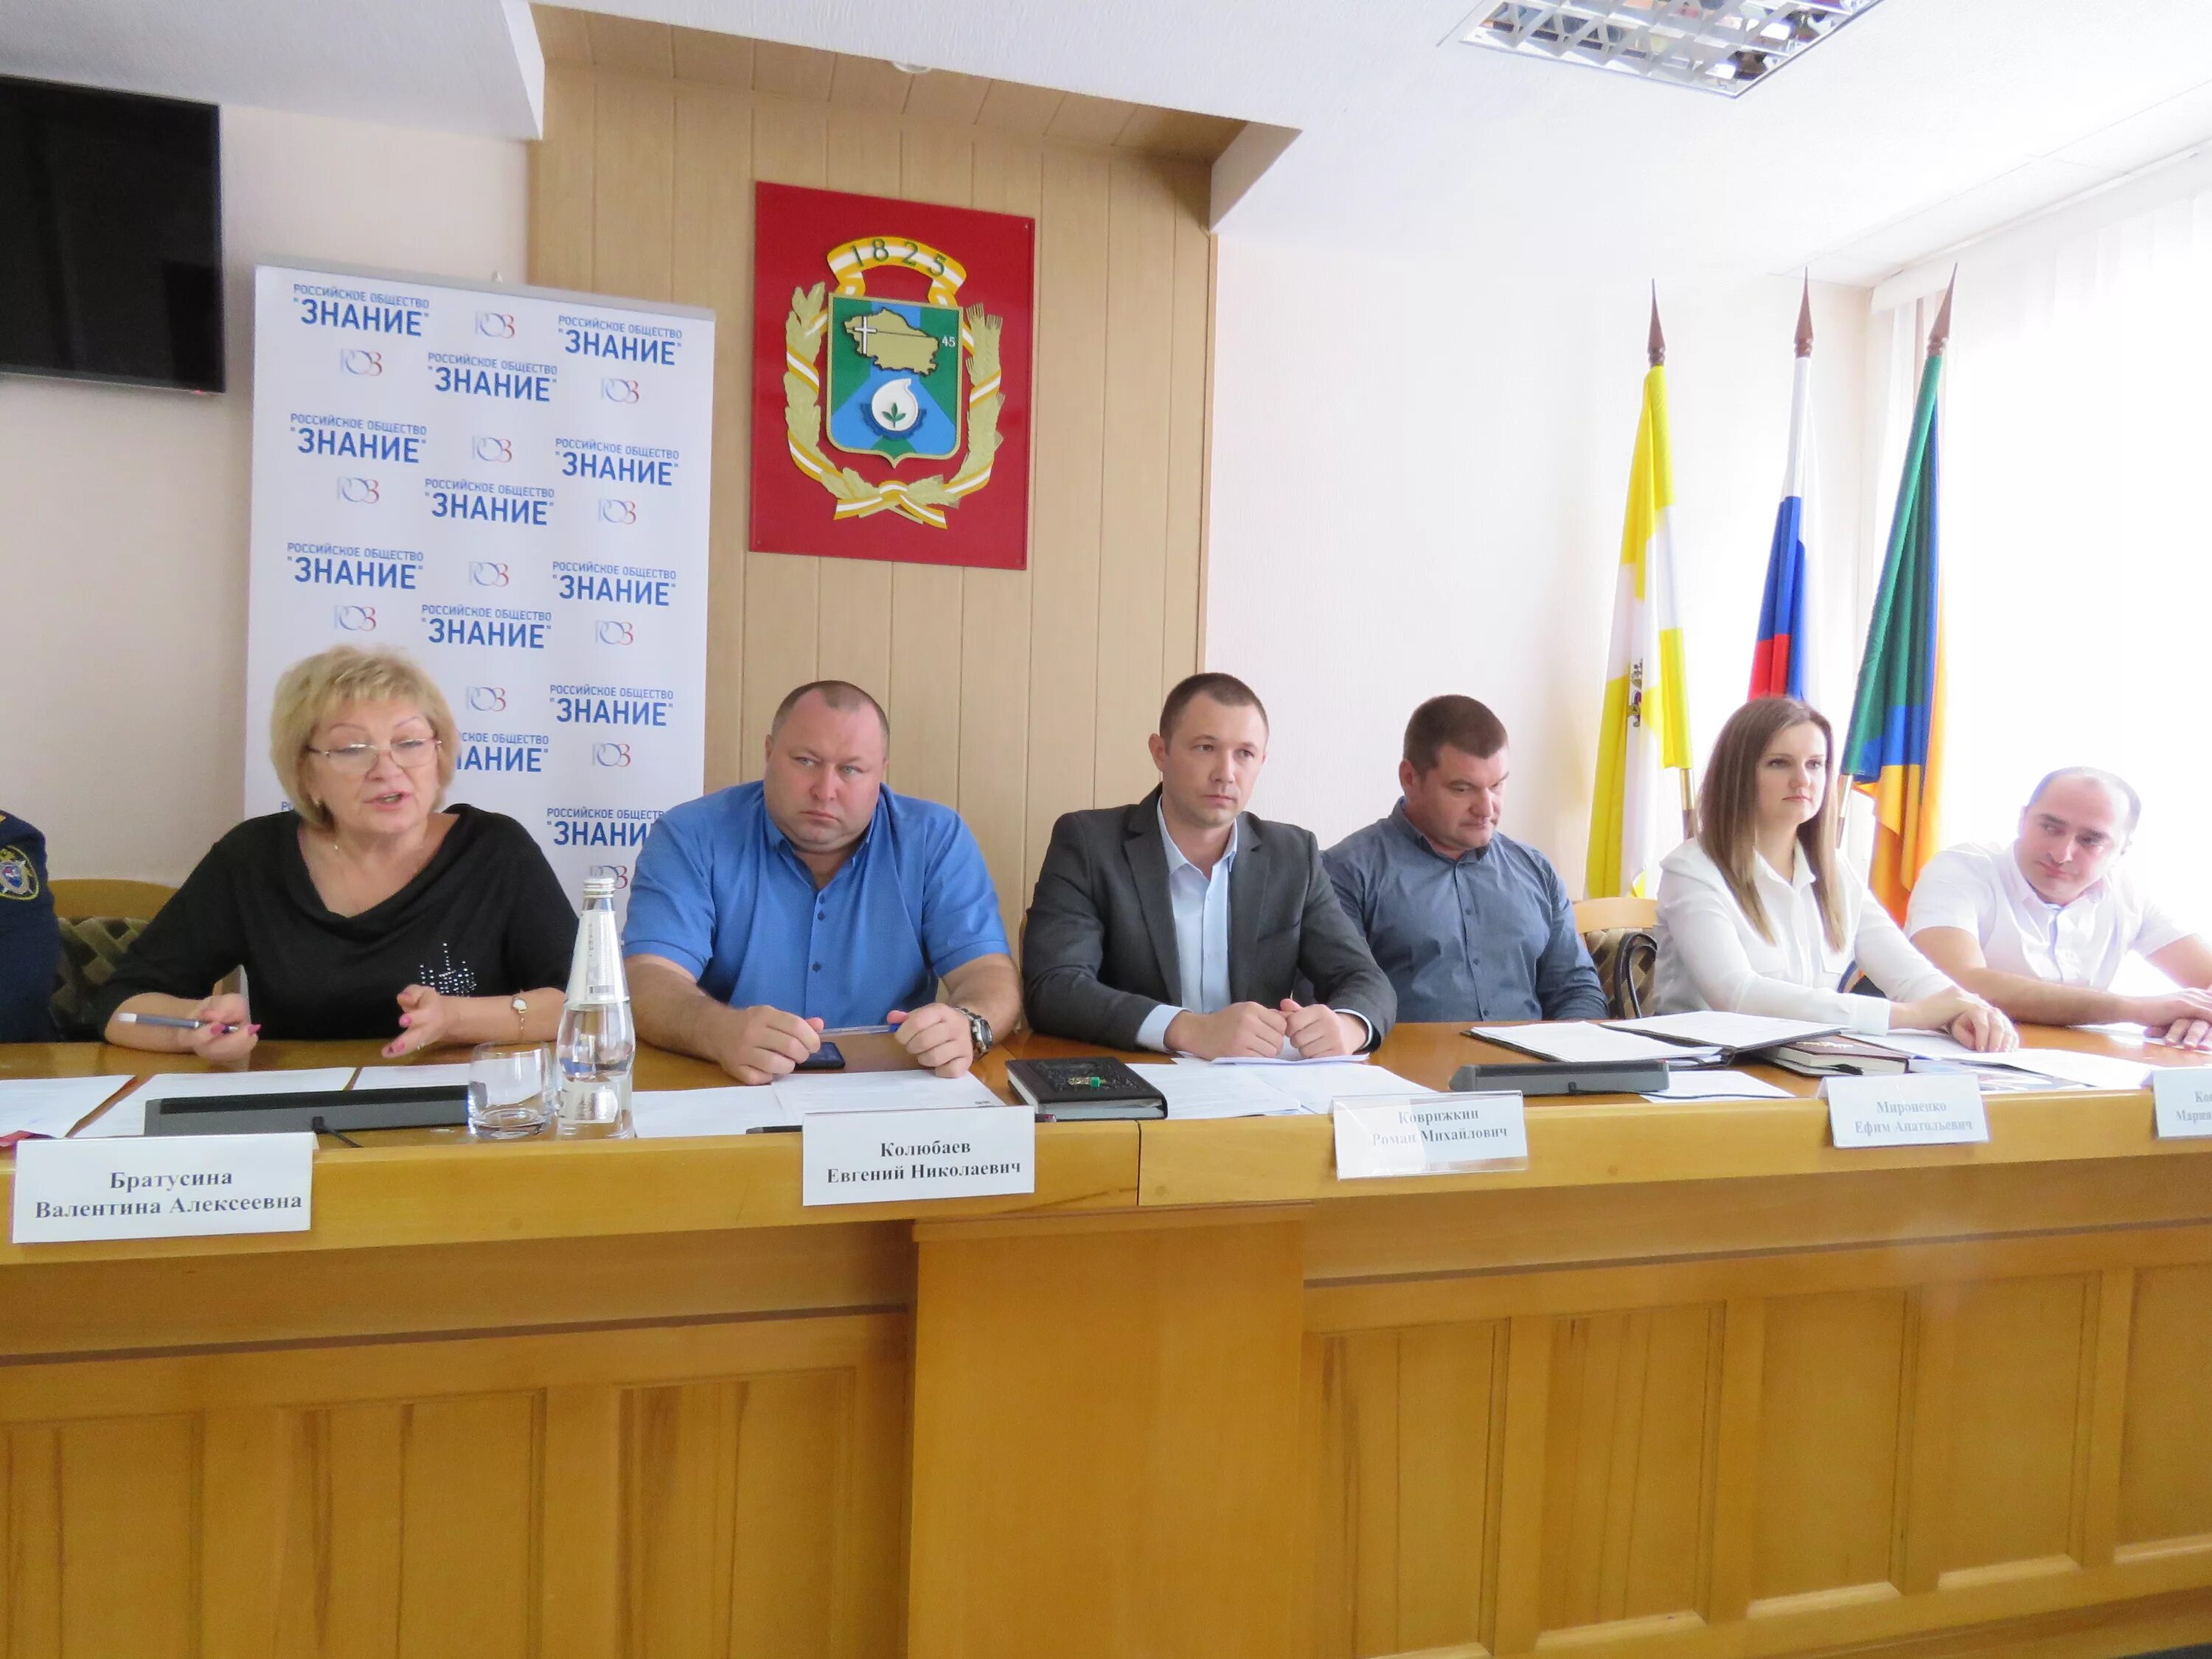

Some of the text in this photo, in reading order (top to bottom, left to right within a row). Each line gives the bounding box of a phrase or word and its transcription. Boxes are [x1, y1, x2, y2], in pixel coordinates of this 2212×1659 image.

[851, 238, 946, 276] 1825
[294, 285, 429, 308] РОССИЙСКОЕ ОБЩЕСТВО
[293, 298, 428, 336] "ЗНАНИЕ"
[558, 316, 682, 339] РОССИЙСКОЕ ОБЩЕСТВО
[558, 329, 681, 366] "ЗНАНИЕ"
[941, 335, 956, 348] 45
[428, 353, 557, 375] РОССИЙСКОЕ ОБЩЕСТВО
[428, 366, 557, 402] "ЗНАНИЕ"
[291, 414, 427, 435] РОССИЙСКОЕ ОБЩЕСТВО
[291, 428, 426, 463] "ЗНАНИЕ"
[555, 439, 679, 459] РОССИЙСКОЕ ОБЩЕСТВО
[555, 452, 678, 486] "ЗНАНИЕ"
[425, 479, 554, 498] РОССИЙСКОЕ ОБЩЕСТВО
[425, 493, 554, 526] "ЗНАНИЕ"
[287, 543, 423, 561] РОССИЙСКОЕ ОБЩЕСТВО
[288, 557, 423, 590] "ЗНАНИЕ"
[552, 561, 676, 579] РОССИЙСКОЕ ОБЩЕСТВО
[552, 575, 675, 606] "ЗНАНИЕ"
[422, 605, 552, 622] РОССИЙСКОЕ ОБЩЕСТВО
[422, 619, 552, 649] "ЗНАНИЕ"
[550, 684, 673, 699] РОССИЙСКОЕ ОБЩЕСТВО
[549, 698, 673, 726] "ЗНАНИЕ"
[492, 734, 549, 745] ОБЩЕСТВО
[455, 745, 549, 772] АНИЕ"
[546, 807, 664, 821] РОССИЙСКОЕ ОБЩЕСТВ
[546, 821, 653, 846] "ЗНАНИ
[1398, 1108, 1479, 1127] Коврижкин
[1854, 1119, 1973, 1136] Ефим Анатольевич
[1372, 1127, 1507, 1147] Роман Михайлович
[880, 1140, 970, 1157] Колюбаев
[109, 1171, 232, 1193] Братусина
[827, 1161, 1020, 1183] Евгений Николаевич
[35, 1195, 302, 1219] Валентина Алексеевна
